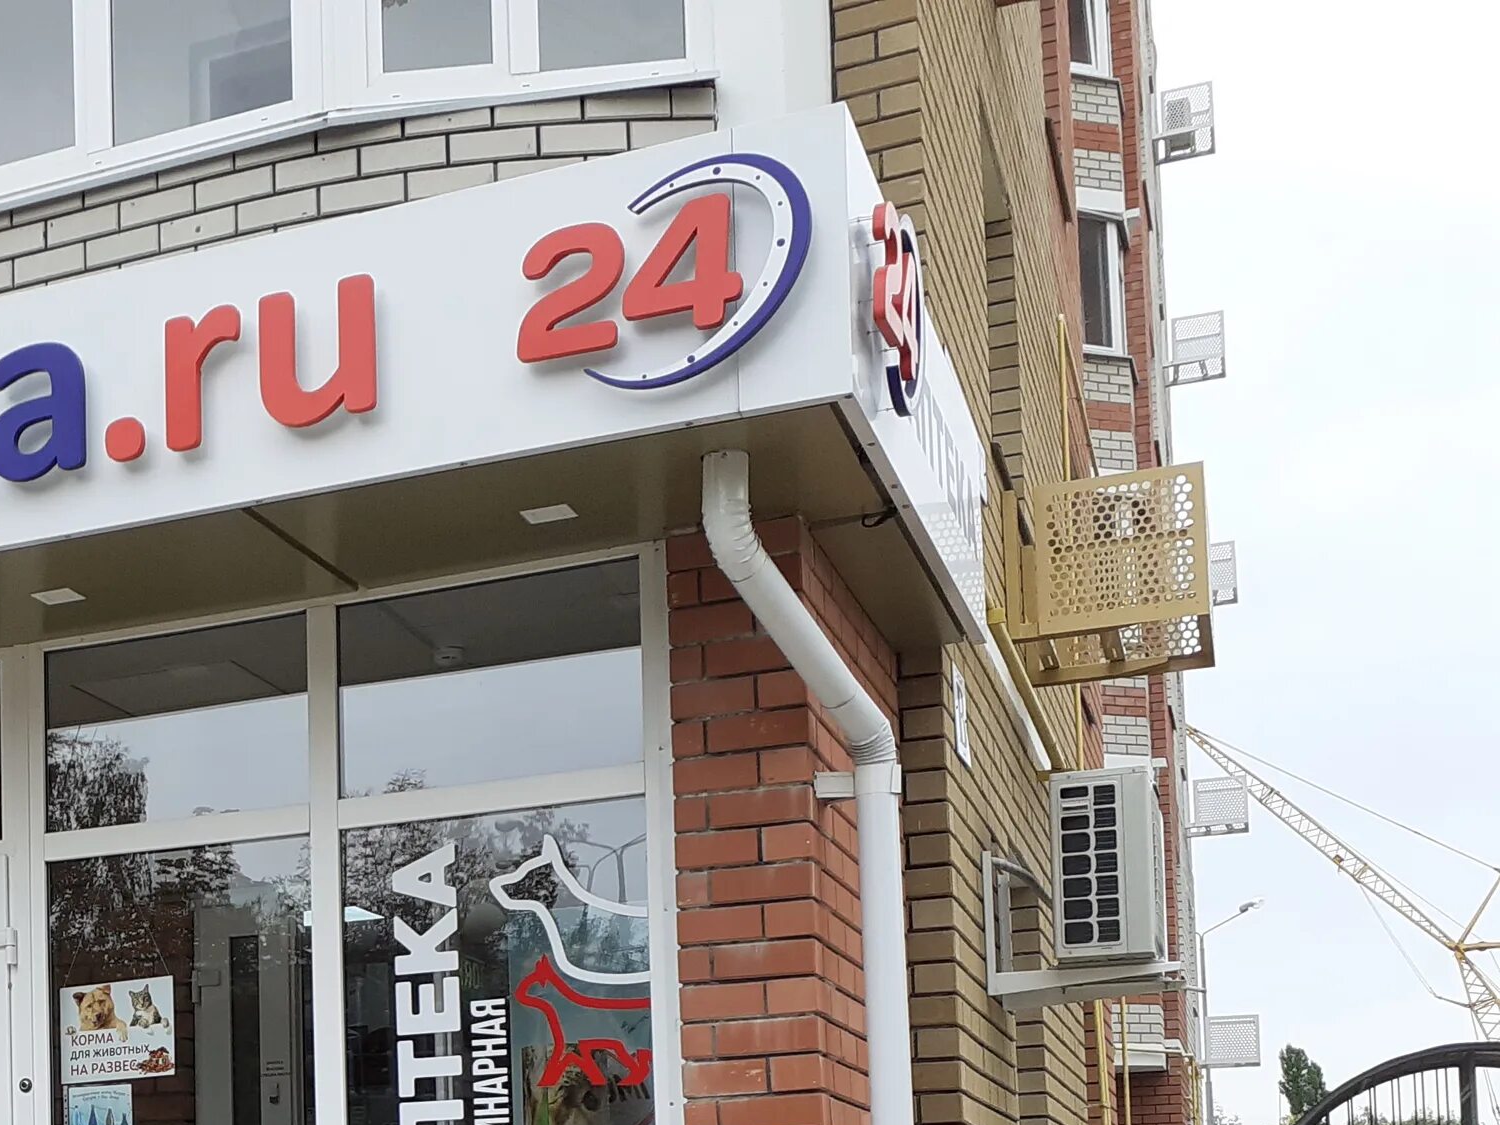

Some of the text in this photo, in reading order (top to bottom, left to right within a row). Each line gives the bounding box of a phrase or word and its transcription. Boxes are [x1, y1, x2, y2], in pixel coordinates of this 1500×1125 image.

[518, 193, 743, 363] 24
[71, 1033, 114, 1046] КОРМА
[70, 1044, 150, 1061] ДЛЯ ЖИВОТНЫХ
[70, 1060, 139, 1076] НА РАЗВЕС
